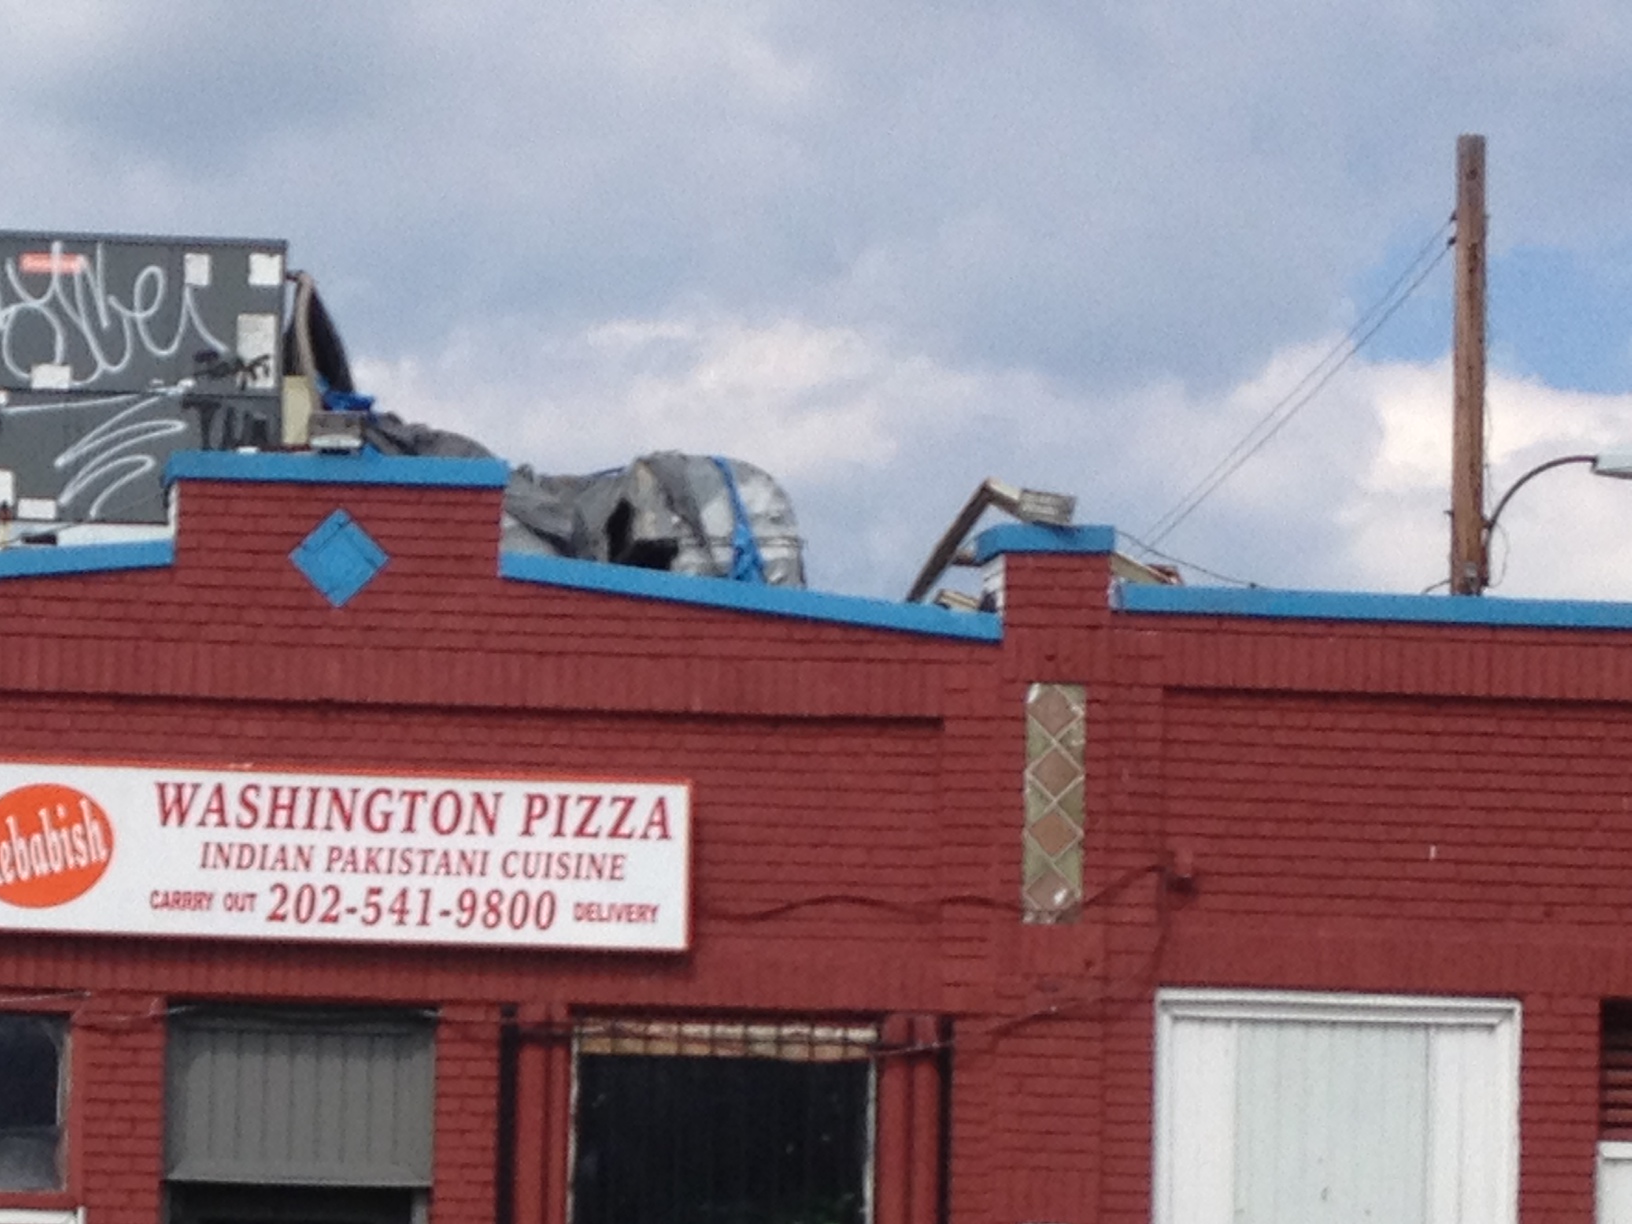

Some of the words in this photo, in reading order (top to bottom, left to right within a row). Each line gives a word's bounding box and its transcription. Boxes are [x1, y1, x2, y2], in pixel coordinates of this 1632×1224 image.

[155, 782, 504, 836] WASHINGTON
[520, 793, 672, 840] PIZZA
[199, 840, 316, 874] INDIAN
[323, 844, 491, 878] PAKISTANI
[501, 851, 626, 883] CUISINE
[223, 891, 257, 912] OUT
[266, 883, 557, 930] 202-541-9800
[573, 900, 659, 924] DELIVERY
